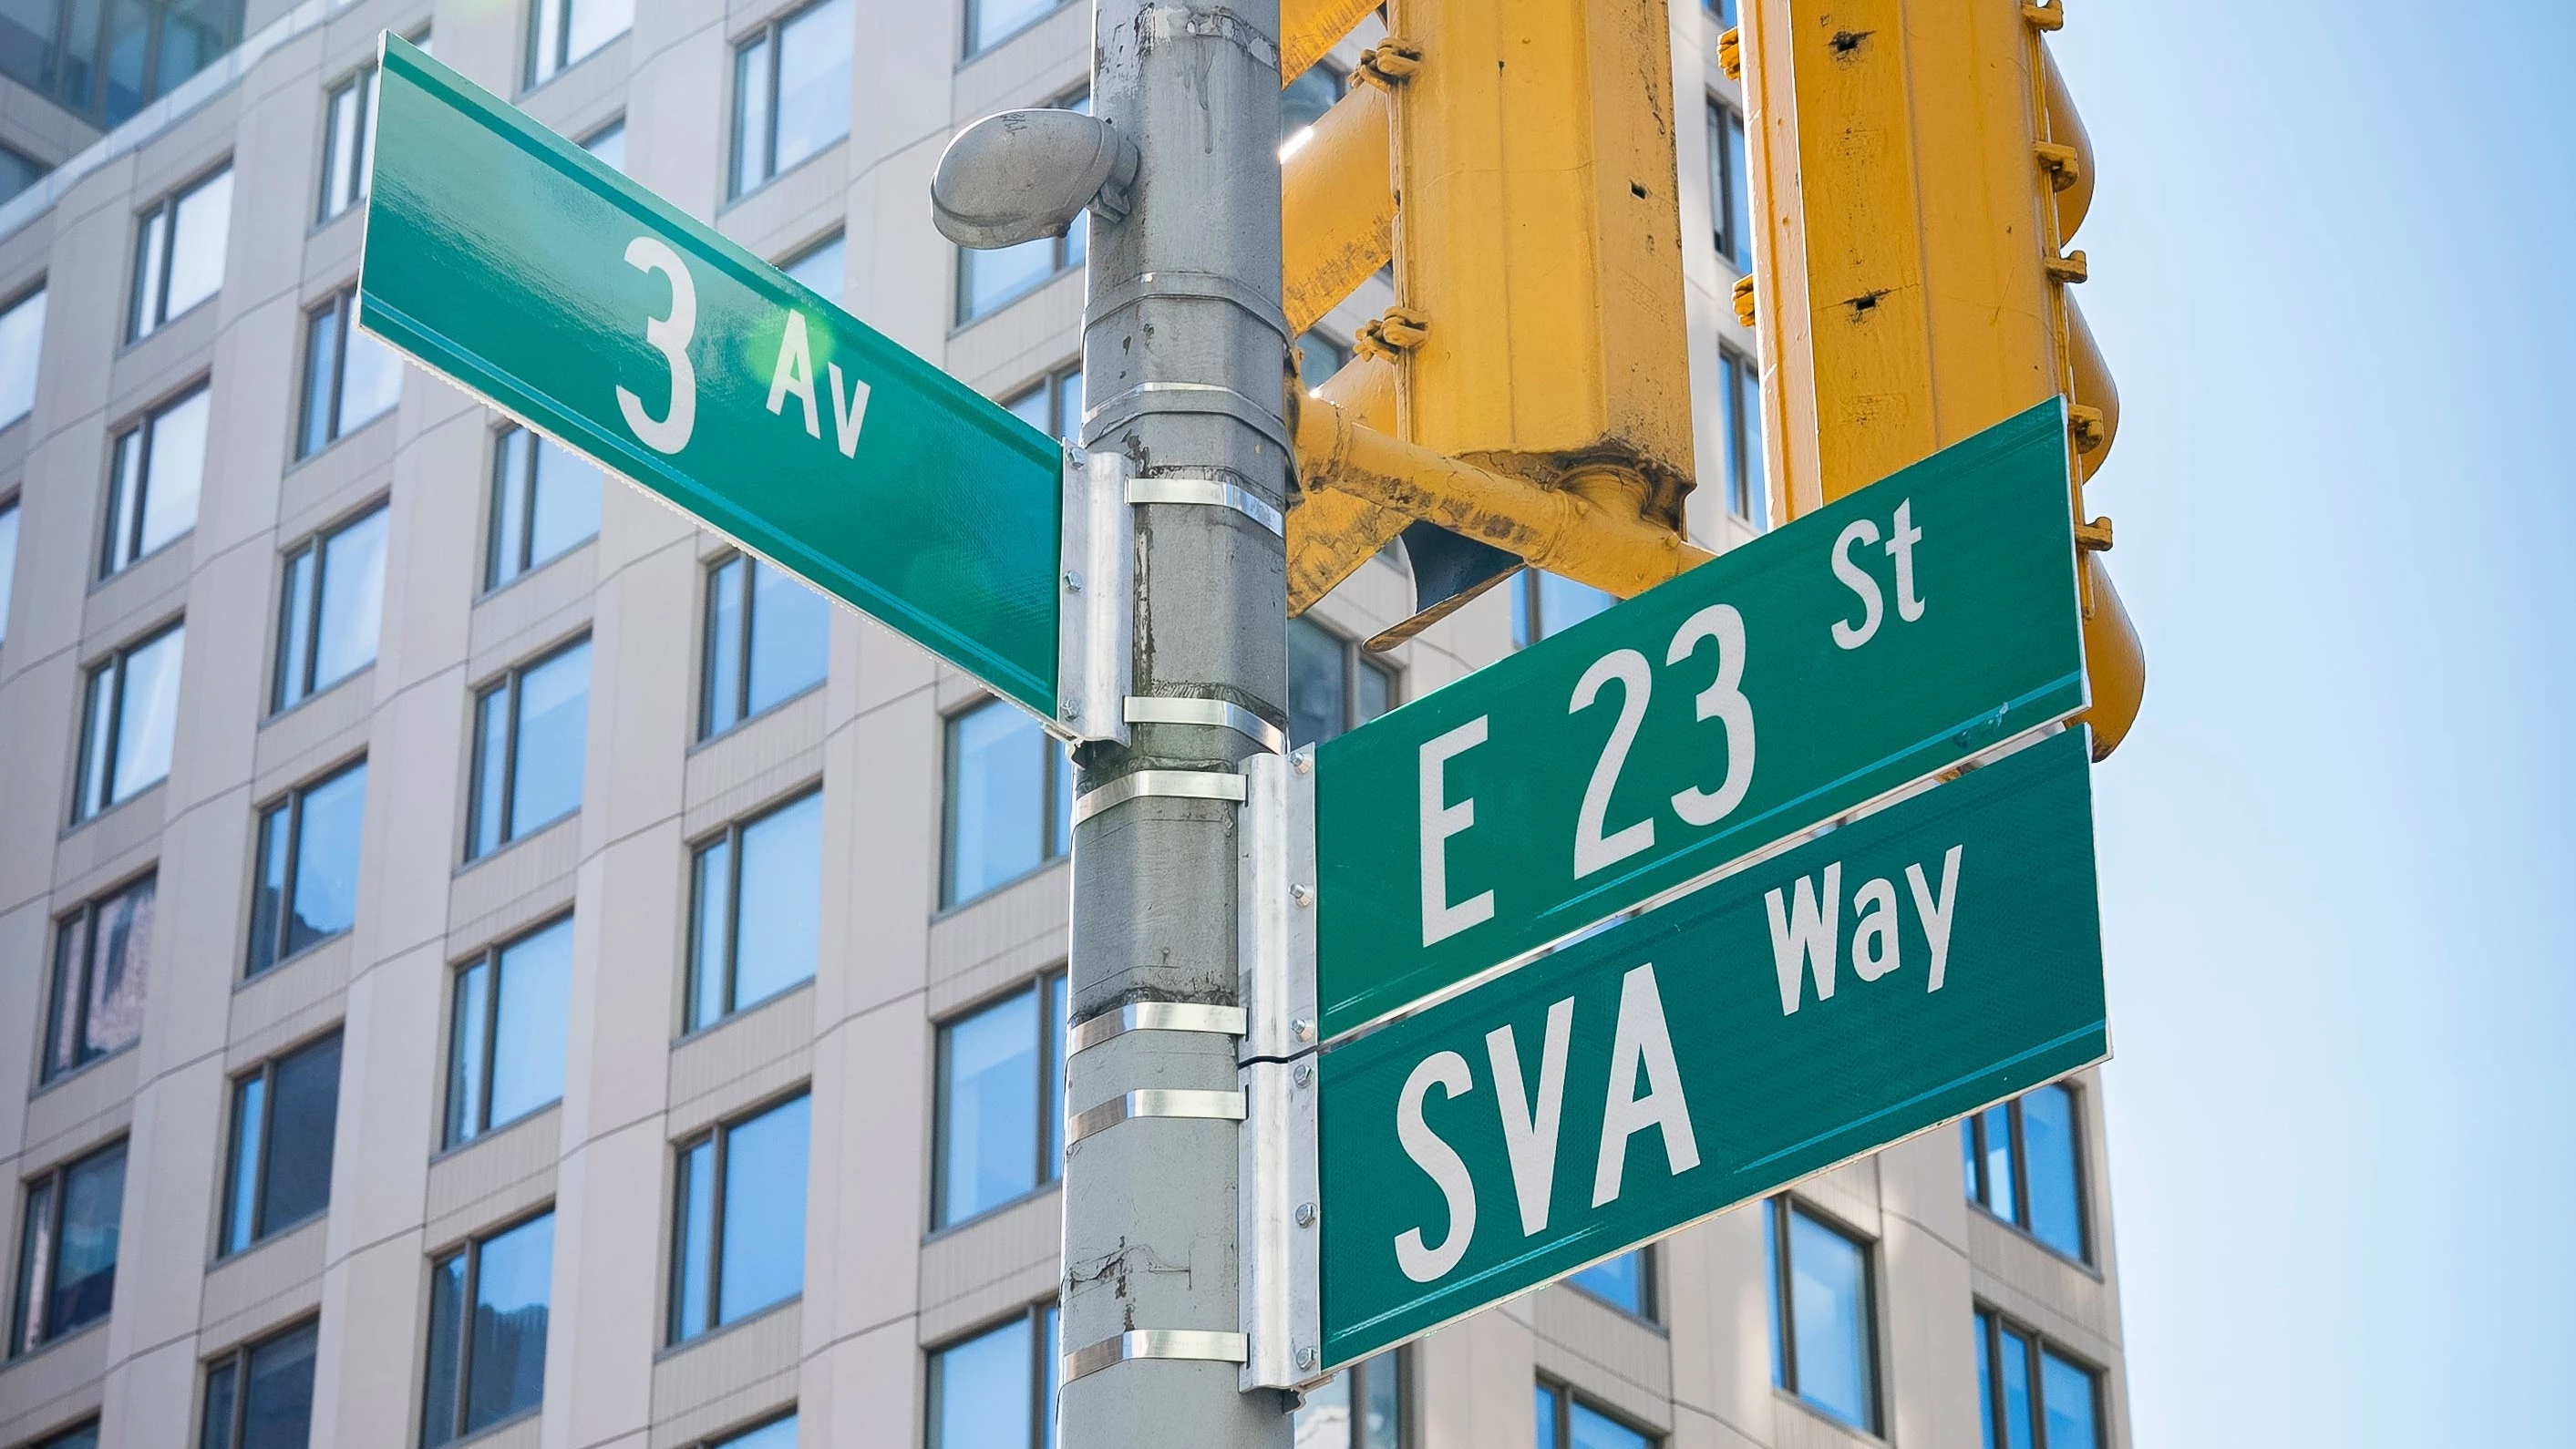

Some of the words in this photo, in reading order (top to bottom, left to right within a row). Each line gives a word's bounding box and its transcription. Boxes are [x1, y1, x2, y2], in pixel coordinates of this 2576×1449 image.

[617, 237, 696, 454] 3
[766, 310, 871, 458] Av
[1420, 714, 1494, 947] E
[1570, 604, 1755, 879] 23
[1832, 498, 1924, 649] St
[1395, 962, 1700, 1282] SVA
[1765, 845, 1963, 1015] Way
